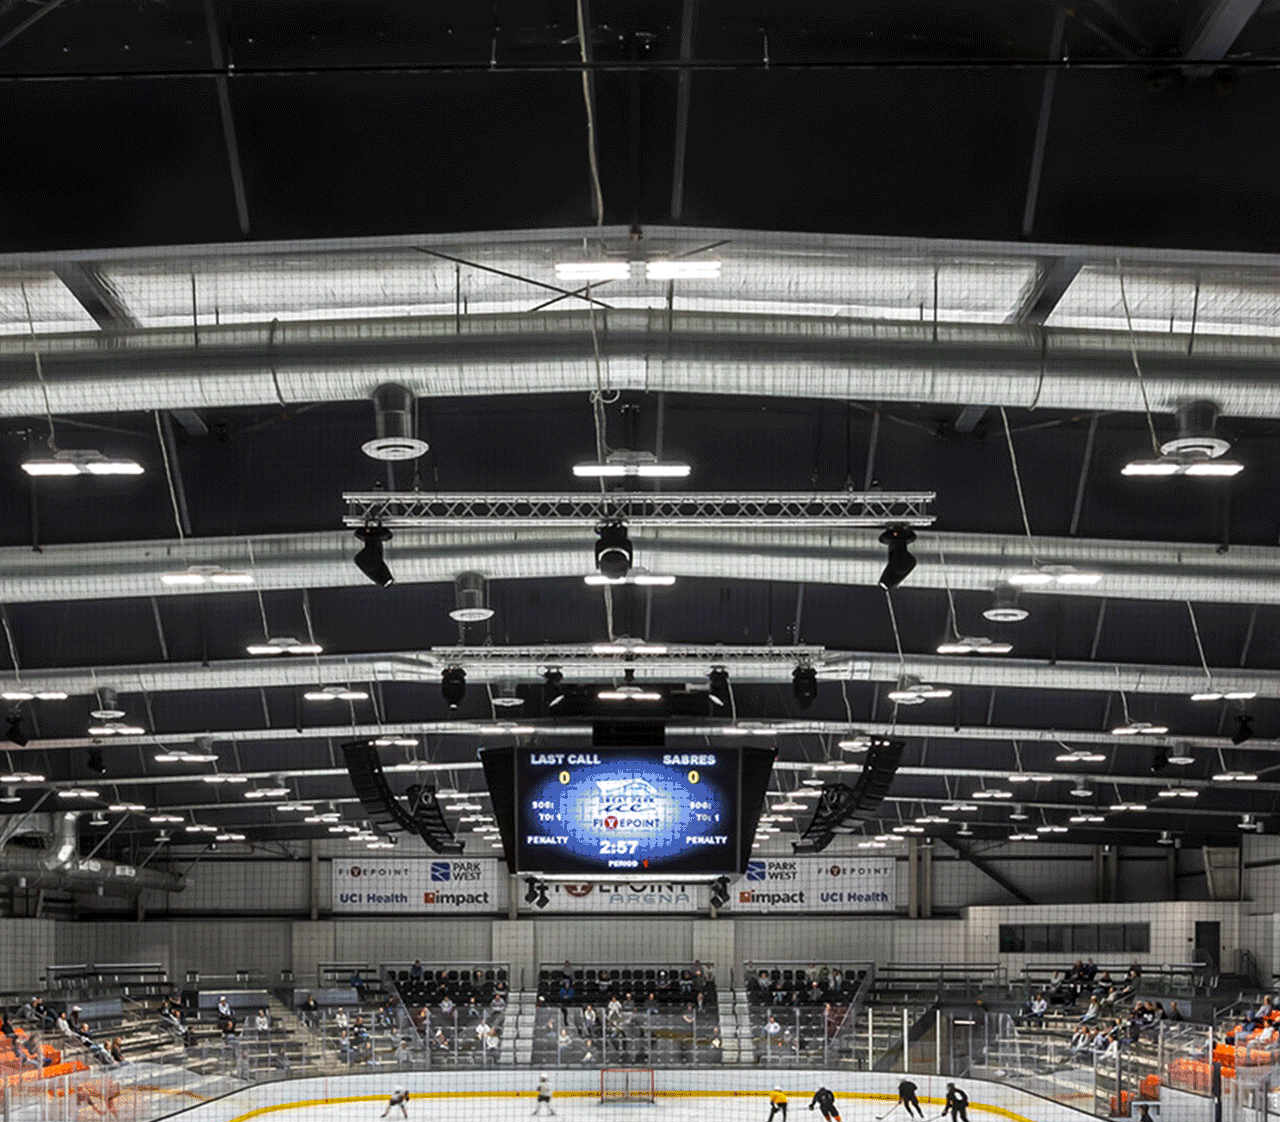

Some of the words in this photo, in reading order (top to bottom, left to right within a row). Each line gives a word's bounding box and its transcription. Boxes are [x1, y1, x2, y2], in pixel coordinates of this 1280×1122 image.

[531, 754, 565, 765] LAST
[567, 754, 602, 765] CALL
[662, 754, 717, 766] SABRES
[559, 771, 570, 785] 0
[688, 770, 700, 784] 0
[527, 836, 569, 845] PENALTY
[686, 836, 728, 845] PENALTY
[599, 840, 639, 854] 2:57
[453, 862, 481, 871] PARK
[608, 860, 639, 868] PERIOD
[768, 862, 797, 871] PARK
[452, 871, 481, 881] WEST
[767, 871, 797, 881] WEST
[340, 893, 362, 903] UCI
[367, 893, 408, 904] Health
[436, 890, 489, 906] impact
[610, 894, 690, 904] ARENA
[751, 889, 805, 905] impact
[820, 892, 844, 903] UCI
[847, 892, 889, 903] Health
